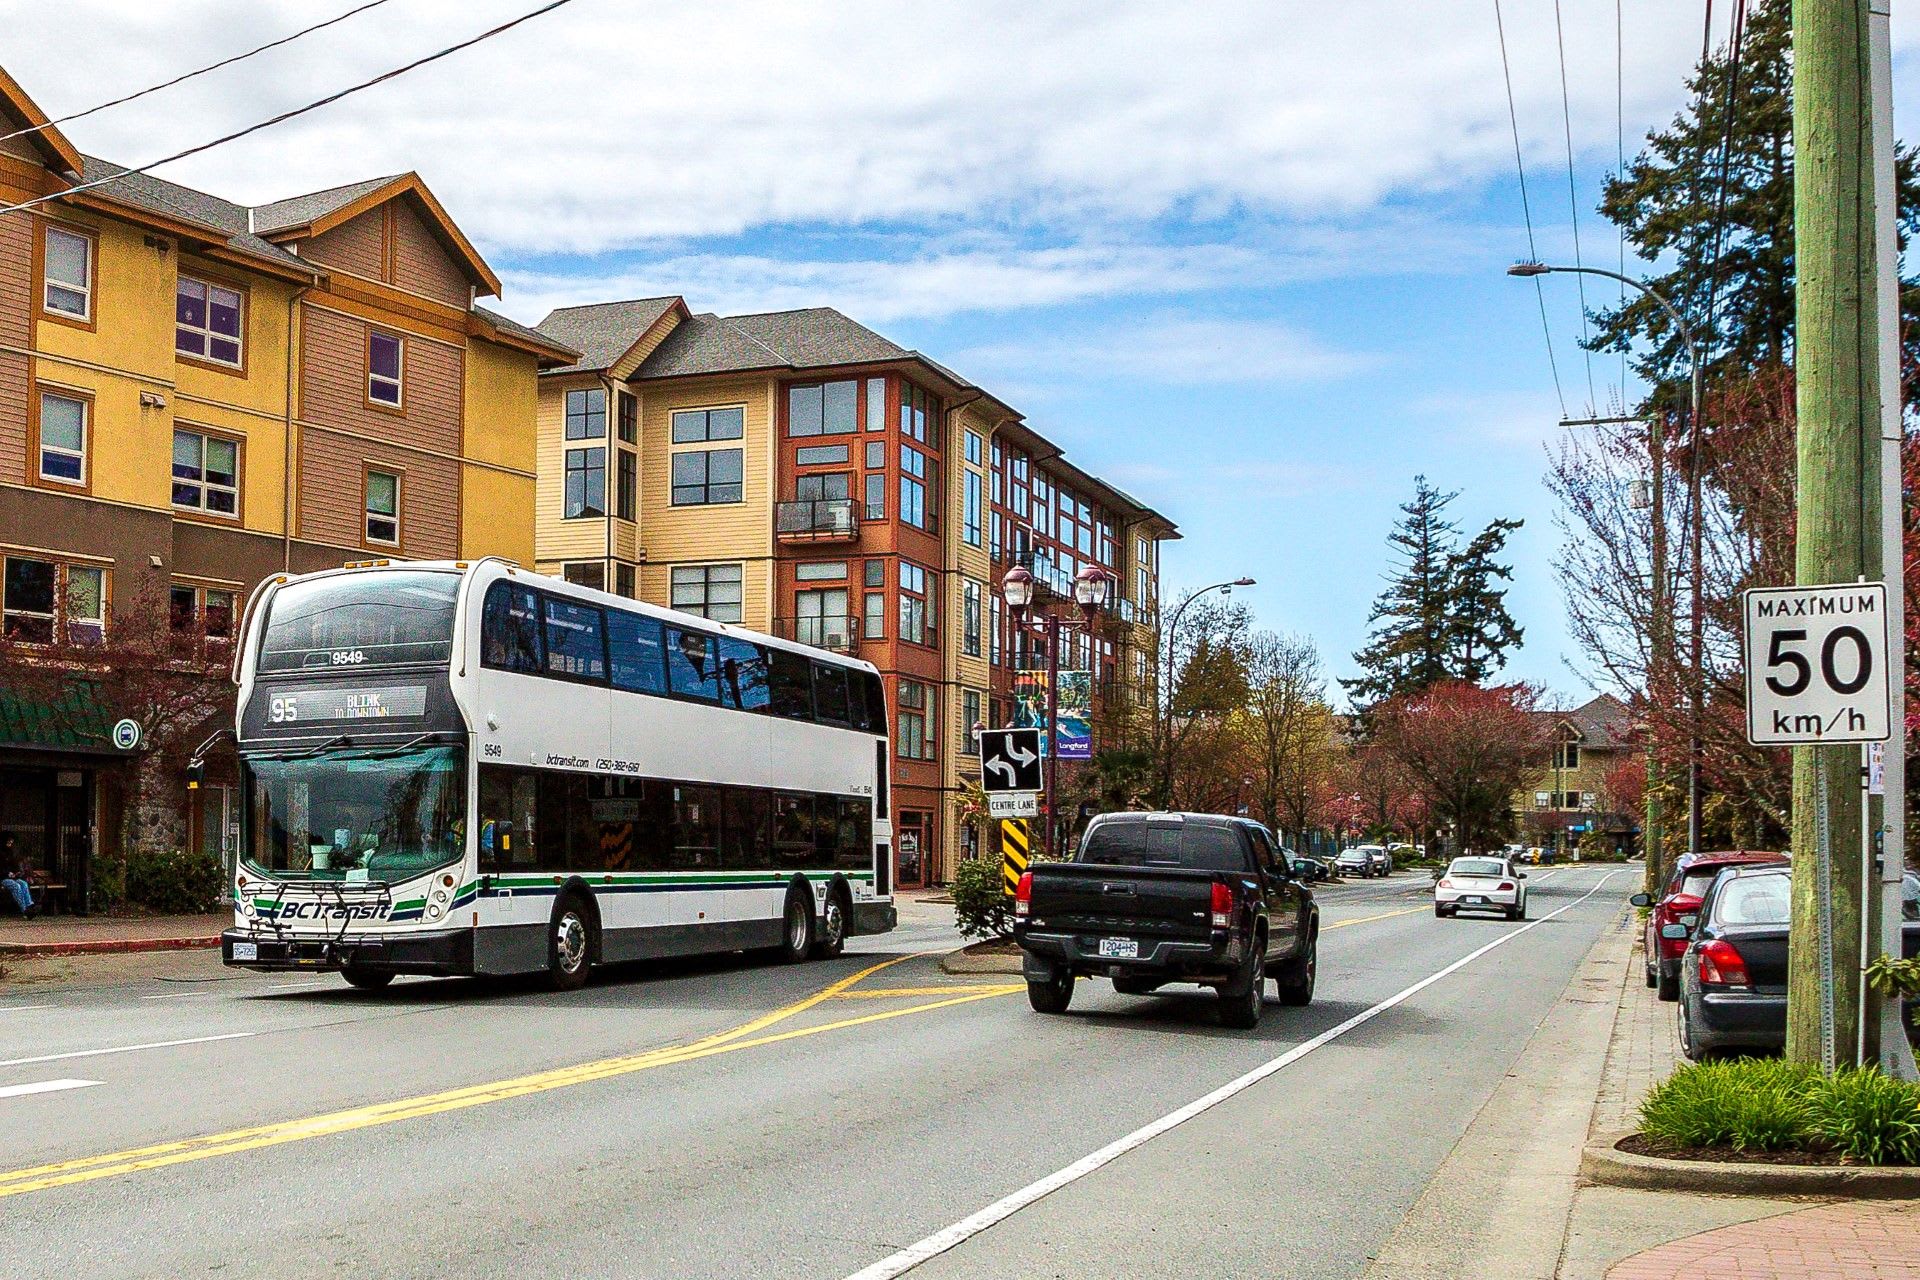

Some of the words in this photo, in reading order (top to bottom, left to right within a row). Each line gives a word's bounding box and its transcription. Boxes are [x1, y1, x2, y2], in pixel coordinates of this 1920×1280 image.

[1758, 594, 1875, 618] MAXIMUM
[332, 651, 363, 665] 9549
[1765, 625, 1872, 697] 50
[271, 697, 298, 723] 95
[1773, 707, 1866, 734] km/h
[484, 743, 502, 758] 9549
[1059, 742, 1089, 751] Langford
[546, 753, 590, 769] bctransit.com
[991, 801, 1016, 811] CENTRE
[1018, 799, 1035, 810] LANE
